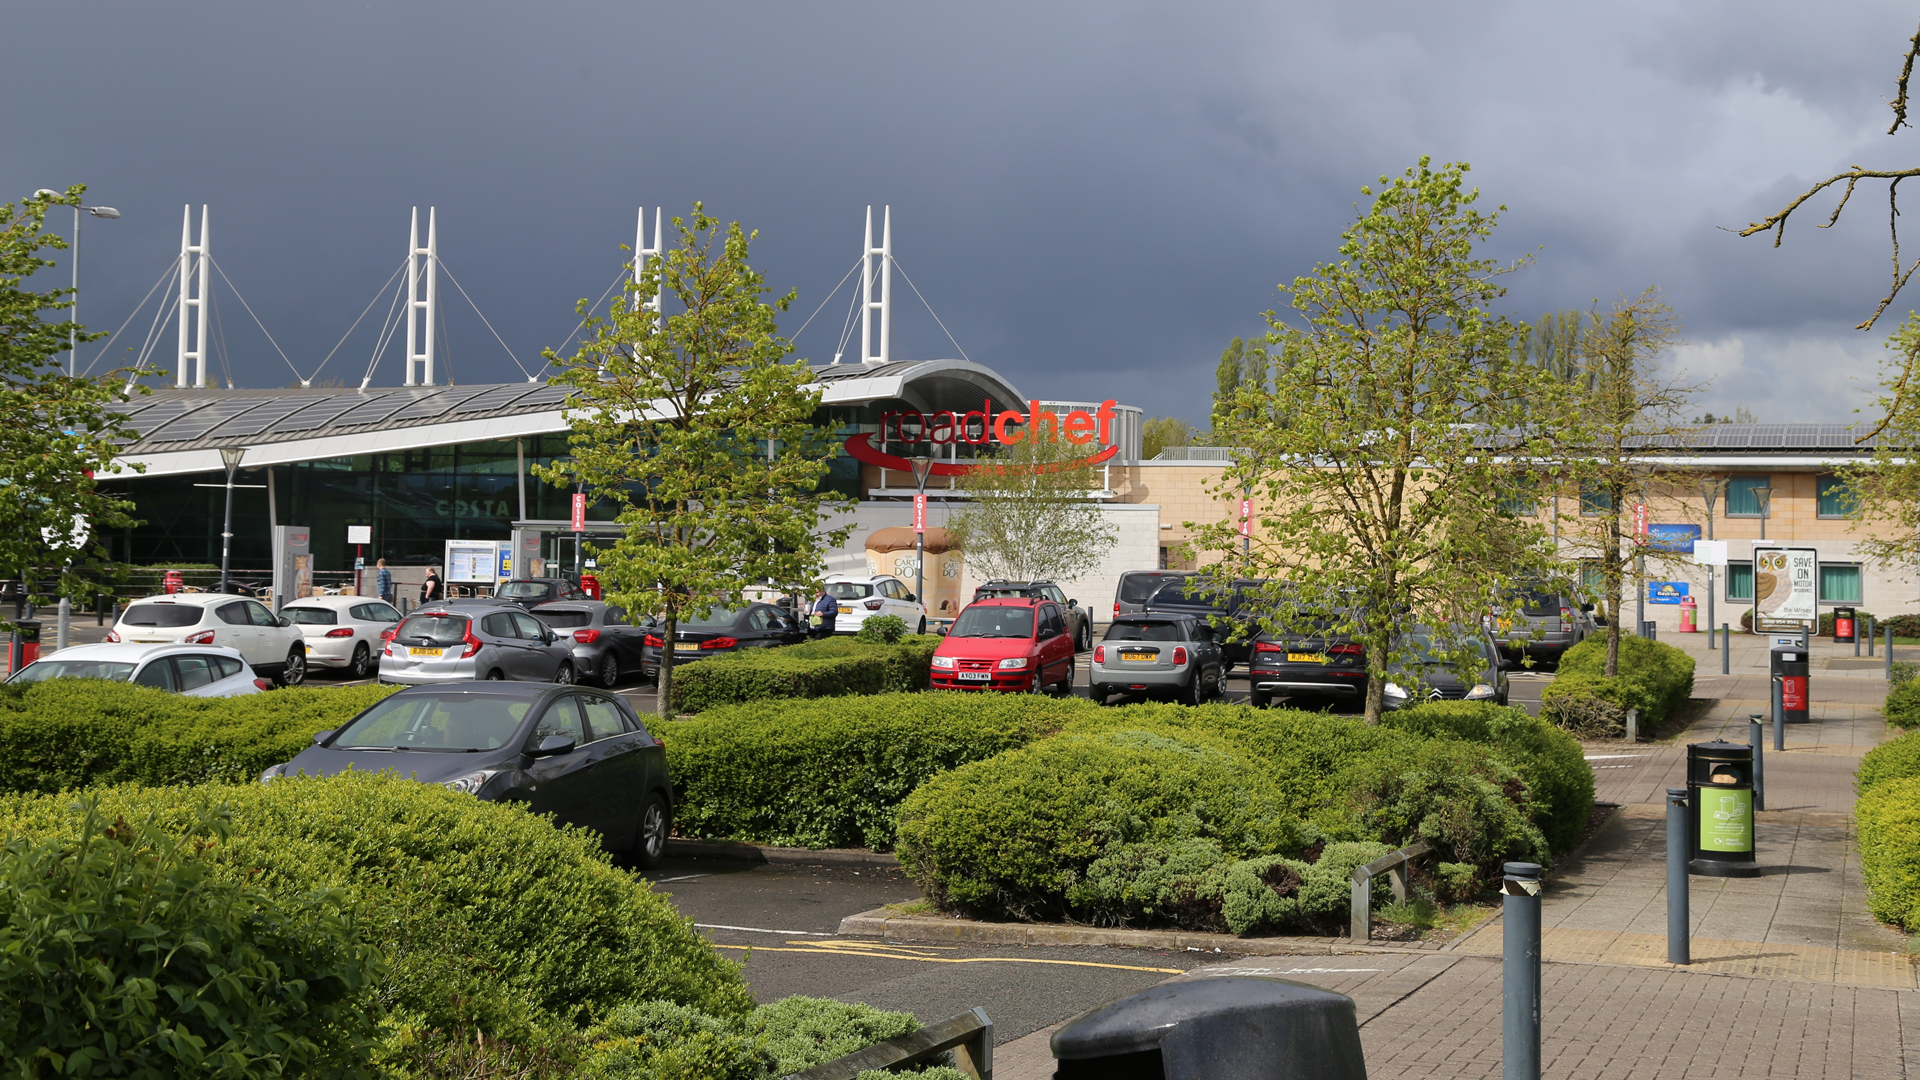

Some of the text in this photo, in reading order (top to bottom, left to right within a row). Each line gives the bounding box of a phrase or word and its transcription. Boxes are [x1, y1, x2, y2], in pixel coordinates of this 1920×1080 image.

[880, 399, 1116, 445] roadchef
[435, 500, 510, 517] COSTA
[1794, 558, 1812, 568] SAVE
[1798, 568, 1809, 580] ON
